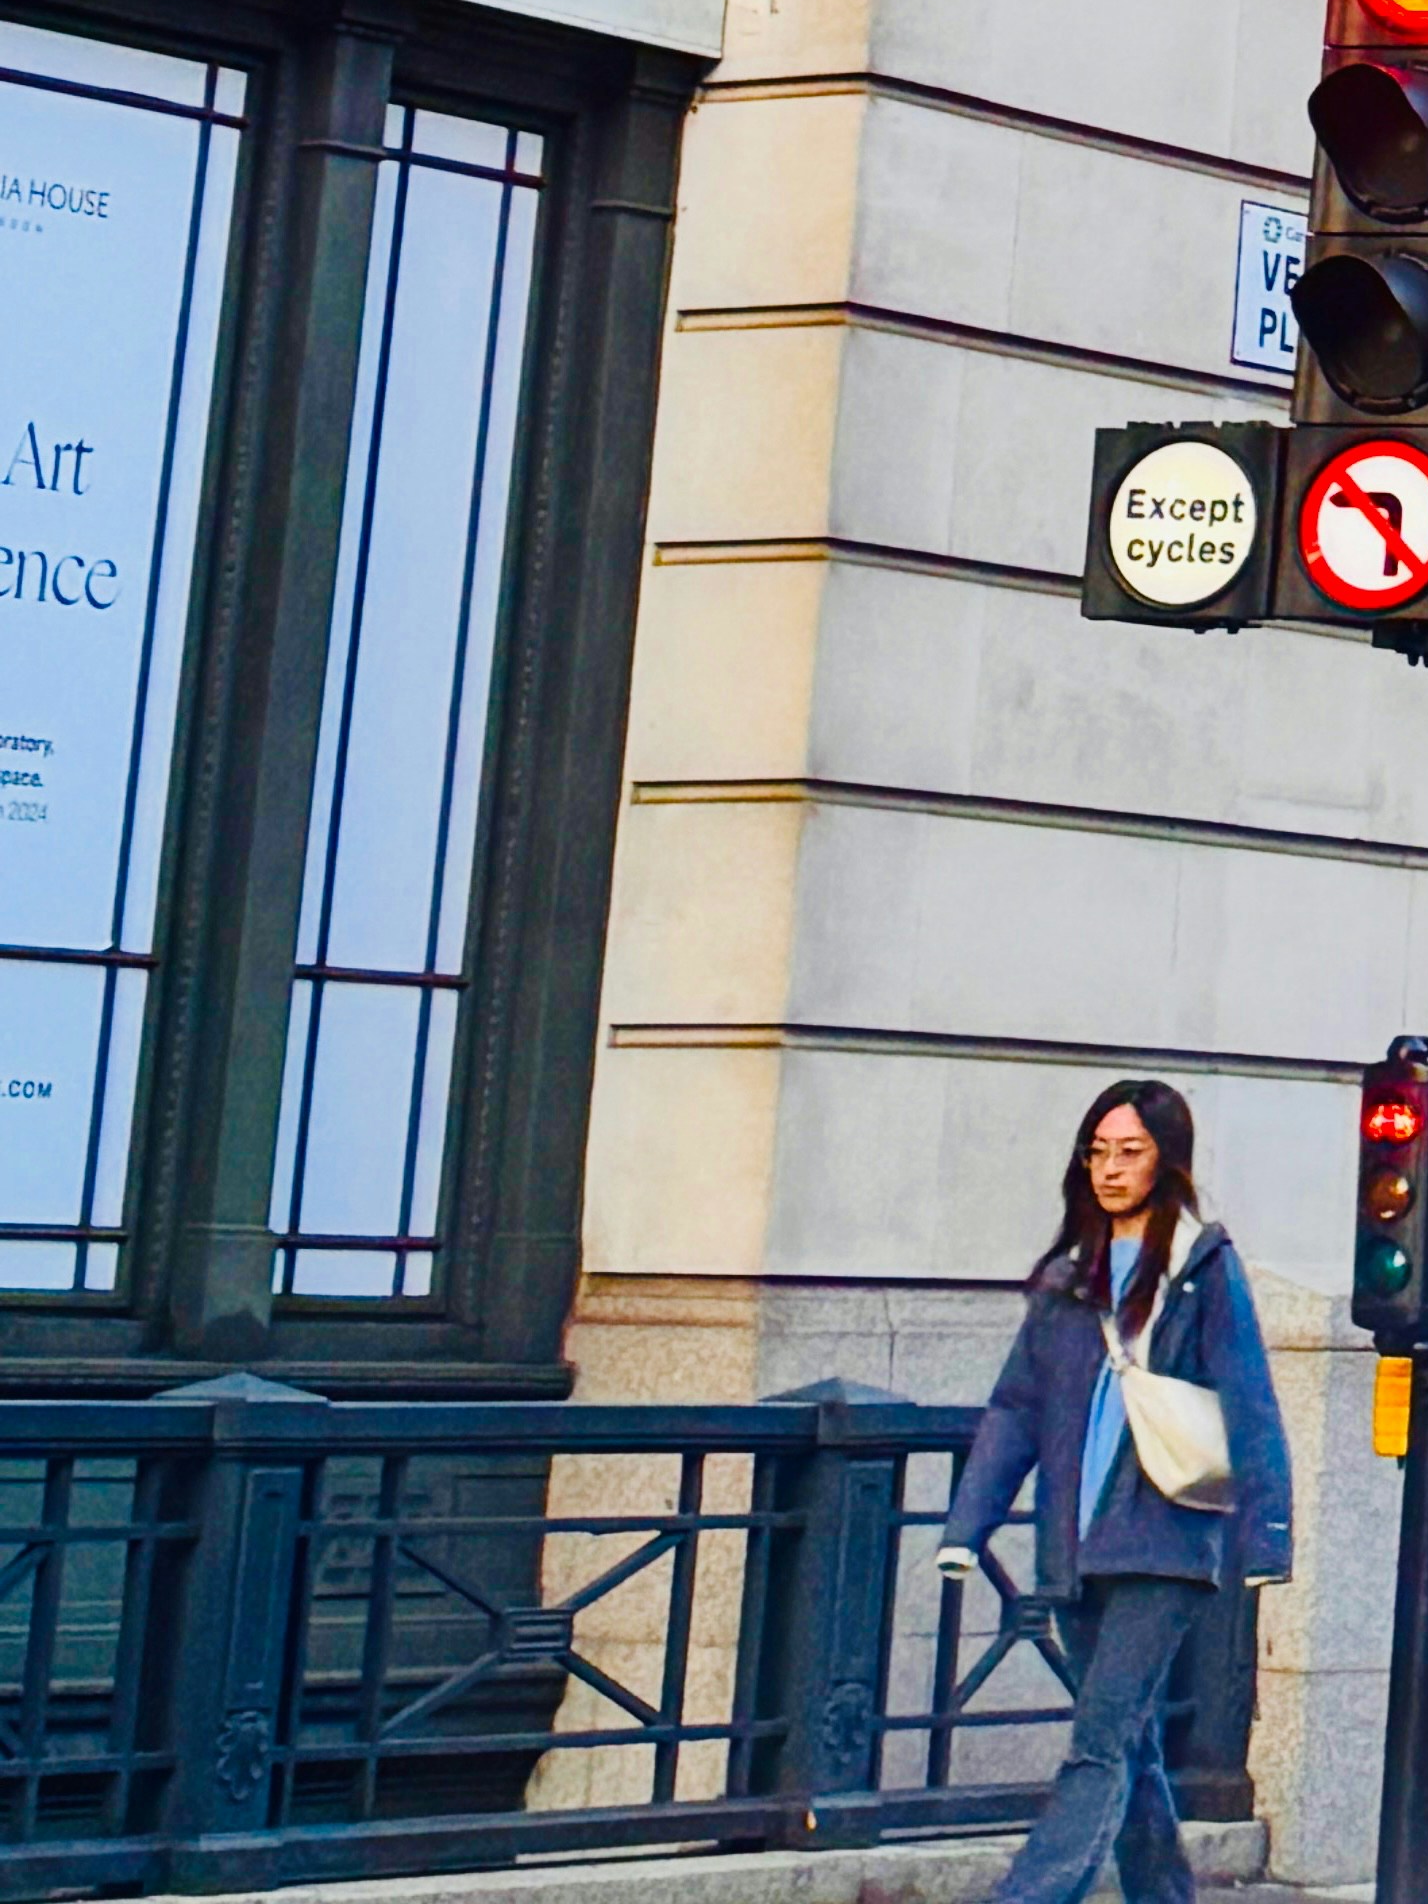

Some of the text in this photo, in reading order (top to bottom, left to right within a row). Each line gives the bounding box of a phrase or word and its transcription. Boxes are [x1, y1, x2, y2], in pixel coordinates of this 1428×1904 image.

[28, 179, 110, 219] HOUSE
[3, 420, 94, 496] Art
[1126, 488, 1245, 527] Except
[1126, 531, 1236, 568] cycles
[0, 1078, 53, 1099] .COM
